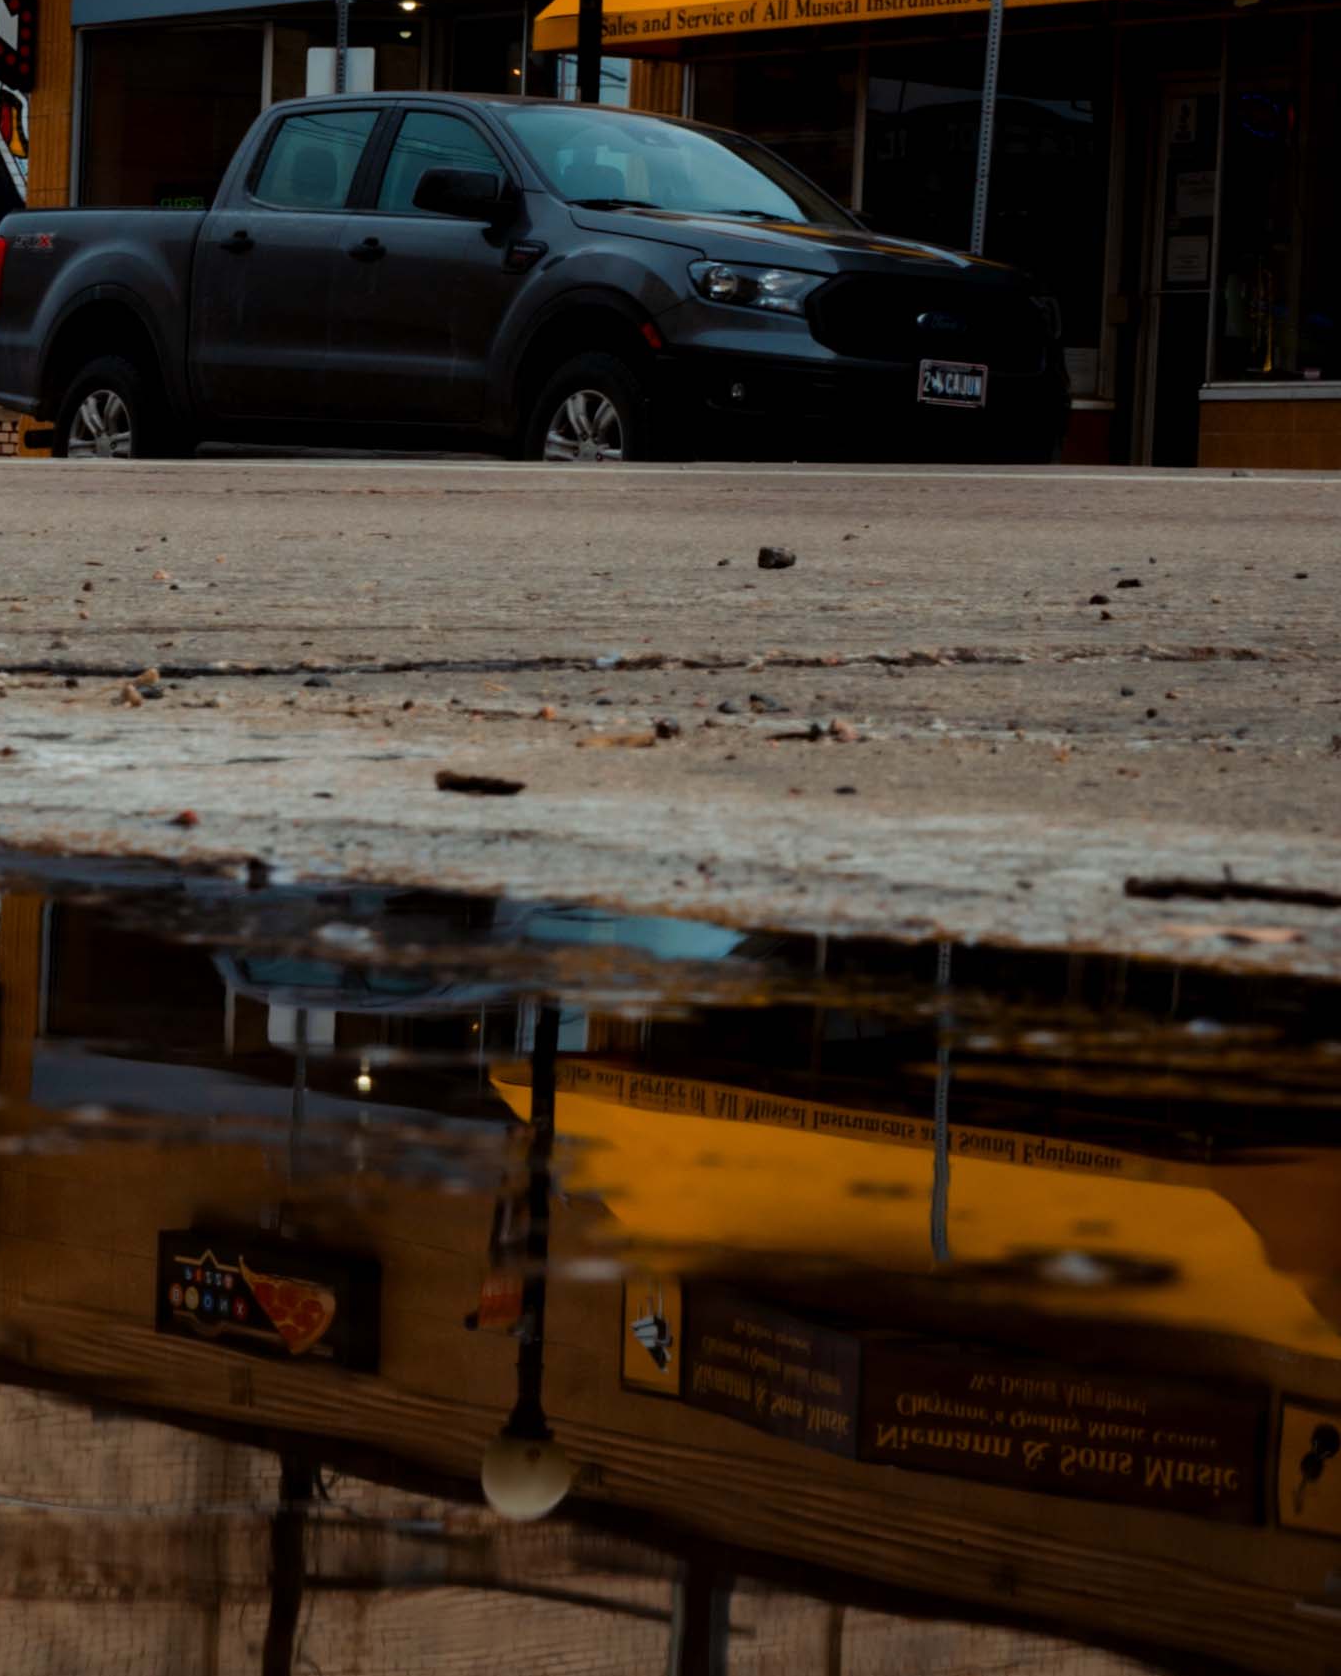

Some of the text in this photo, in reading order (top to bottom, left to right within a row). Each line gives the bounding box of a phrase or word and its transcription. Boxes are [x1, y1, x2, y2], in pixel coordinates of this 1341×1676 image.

[642, 11, 671, 33] and
[676, 9, 735, 30] Service
[739, 5, 757, 23] of
